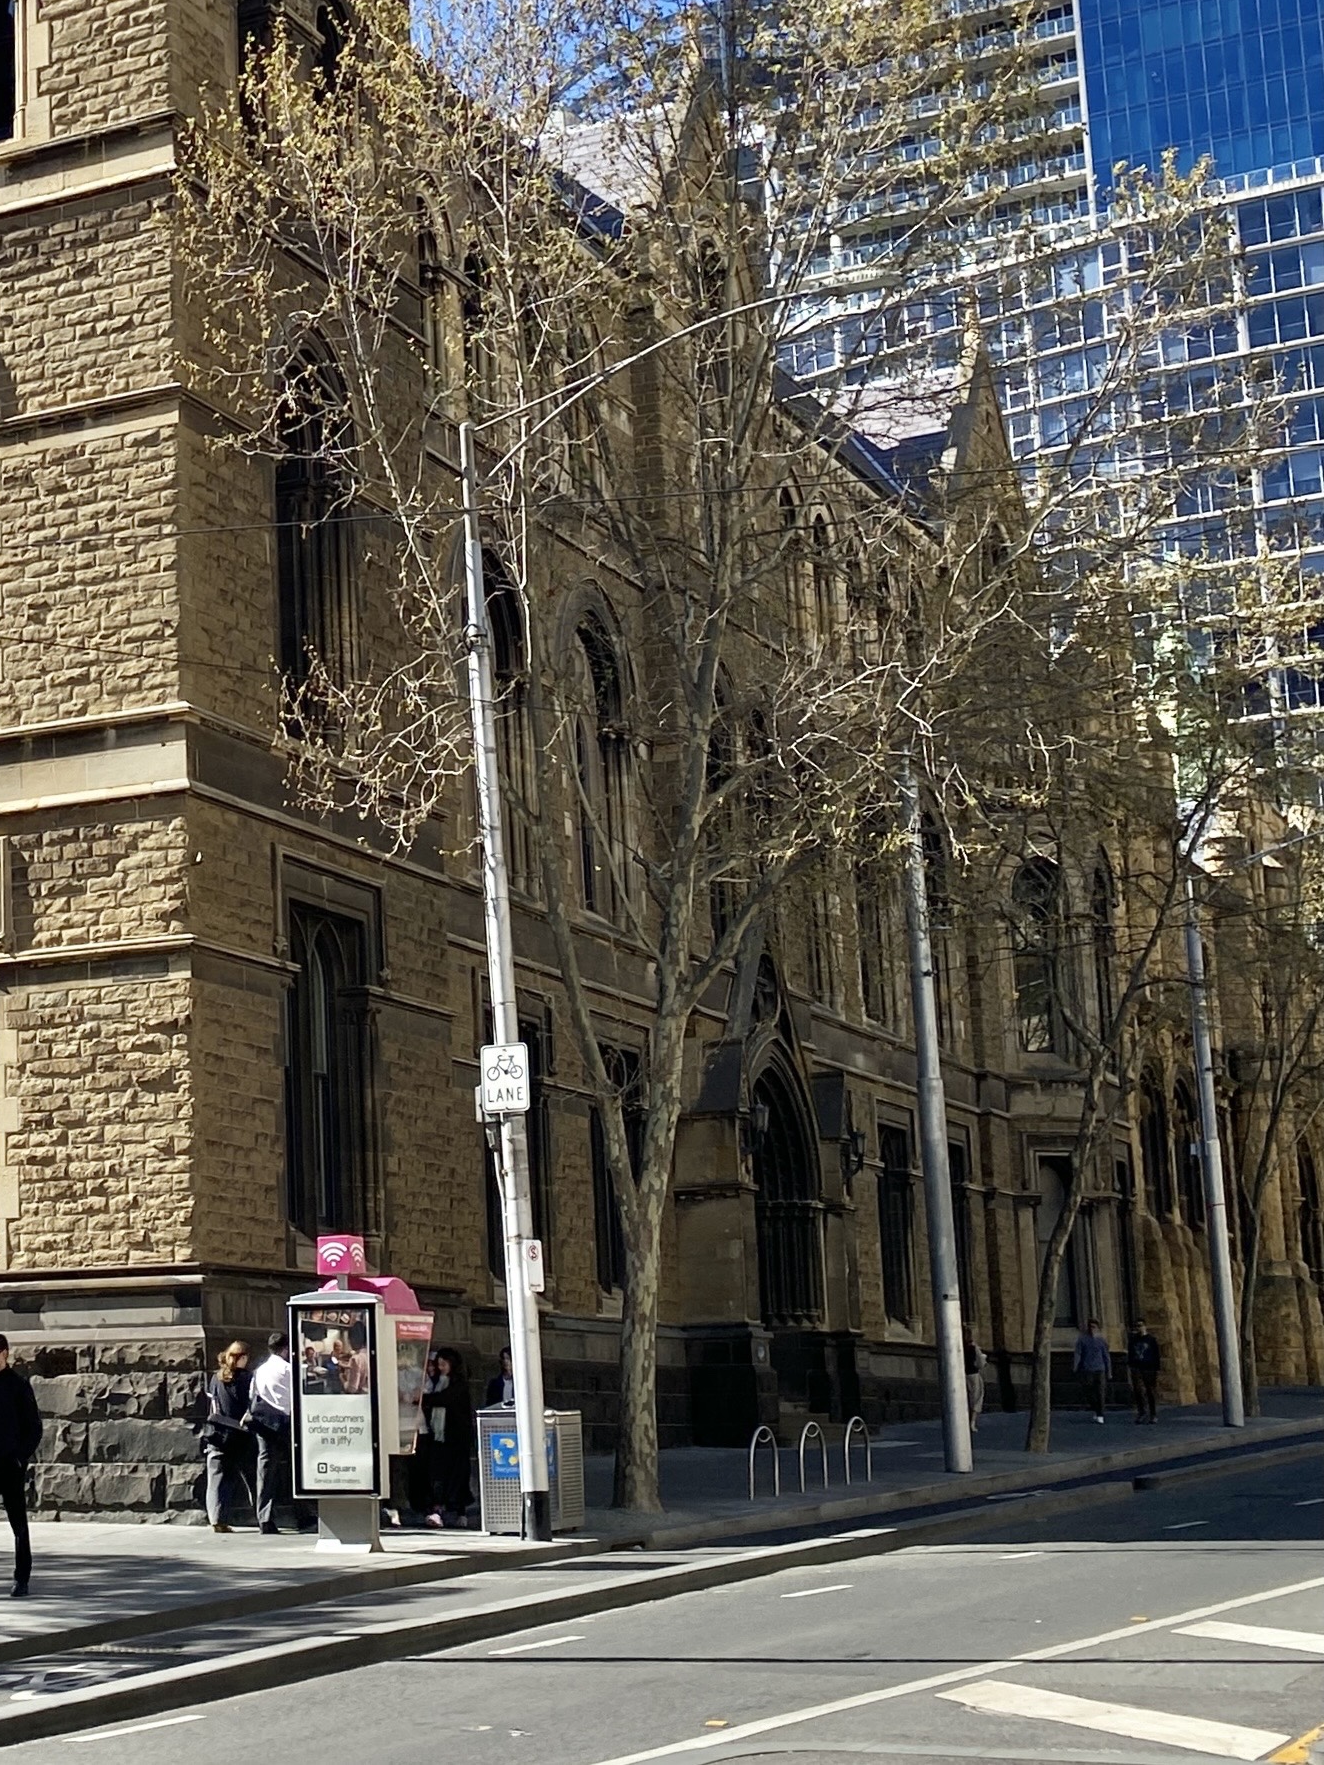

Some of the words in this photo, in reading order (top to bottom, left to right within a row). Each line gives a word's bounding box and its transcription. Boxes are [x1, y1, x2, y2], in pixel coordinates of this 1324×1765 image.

[487, 1086, 524, 1103] LANE
[307, 1414, 320, 1423] Let
[321, 1414, 364, 1423] customers
[308, 1425, 329, 1434] order
[331, 1425, 347, 1434] and
[349, 1426, 364, 1436] pay
[321, 1436, 329, 1445] in
[330, 1437, 336, 1445] a
[329, 1464, 356, 1473] Square
